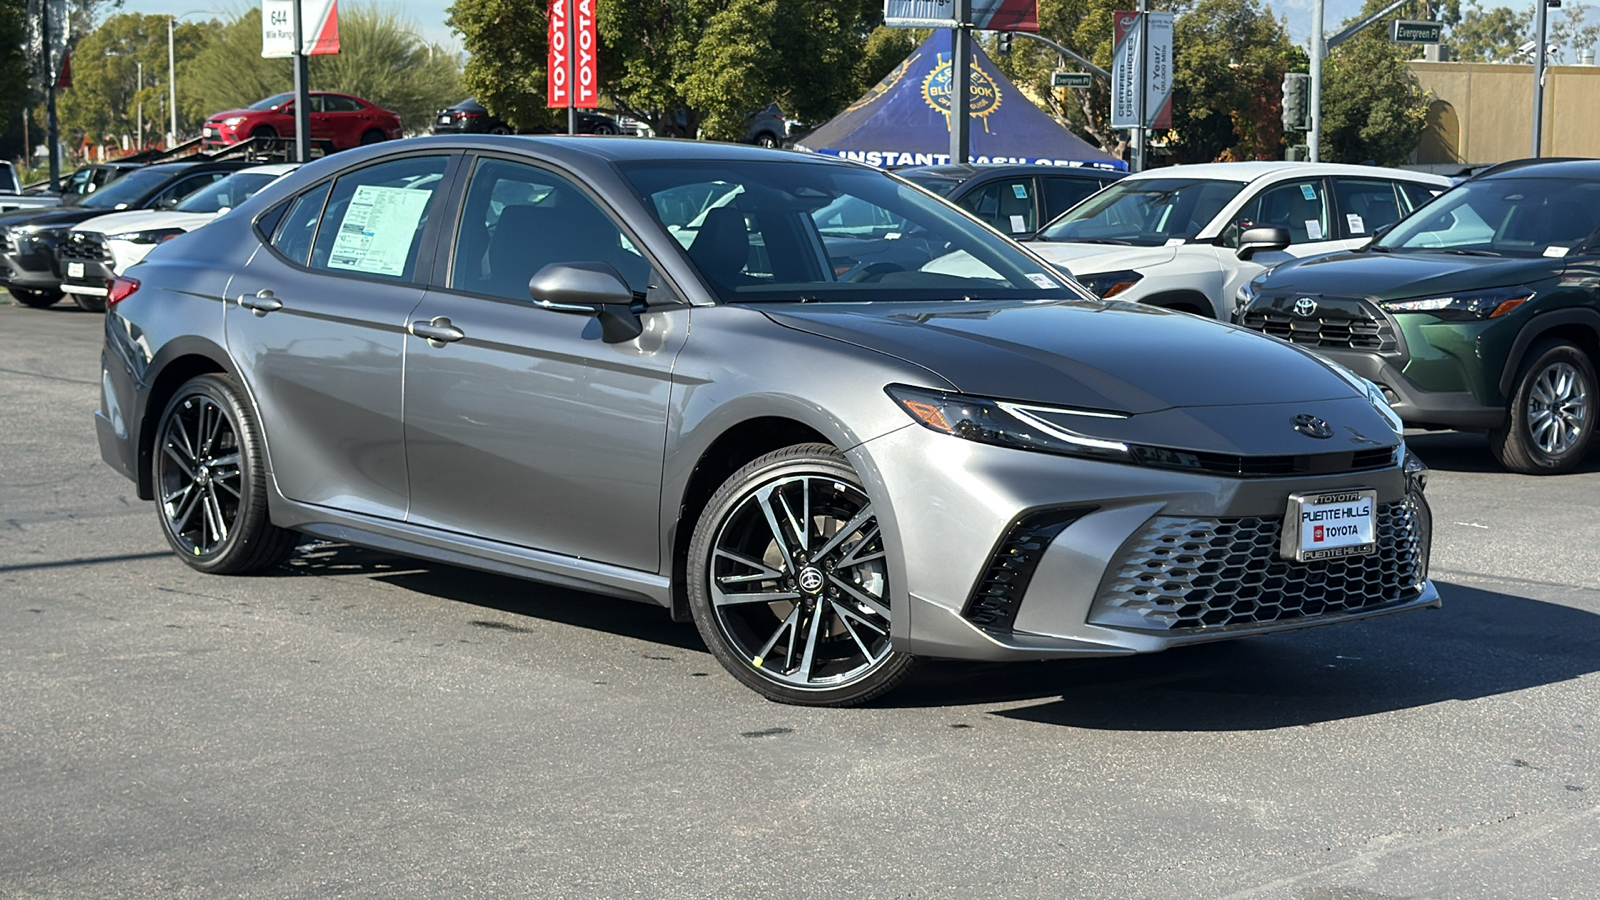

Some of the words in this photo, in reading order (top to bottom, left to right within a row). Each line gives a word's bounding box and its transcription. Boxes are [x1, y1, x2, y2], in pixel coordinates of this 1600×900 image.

[271, 10, 287, 26] 644
[266, 30, 277, 39] Mile
[278, 29, 294, 40] Rang
[1398, 27, 1430, 40] Evergreen
[1431, 28, 1439, 39] Pl
[553, 0, 565, 101] TOYOTA
[579, 0, 592, 101] TOYOTA
[935, 67, 987, 84] KEEY
[839, 151, 950, 167] INSTANT
[1320, 494, 1358, 503] TOYOTA
[1302, 509, 1341, 522] PUENTE
[1342, 506, 1369, 518] HILLS
[1326, 525, 1358, 537] TOYOTA
[1304, 549, 1342, 560] PUENTE
[1343, 545, 1371, 556] HILLS
